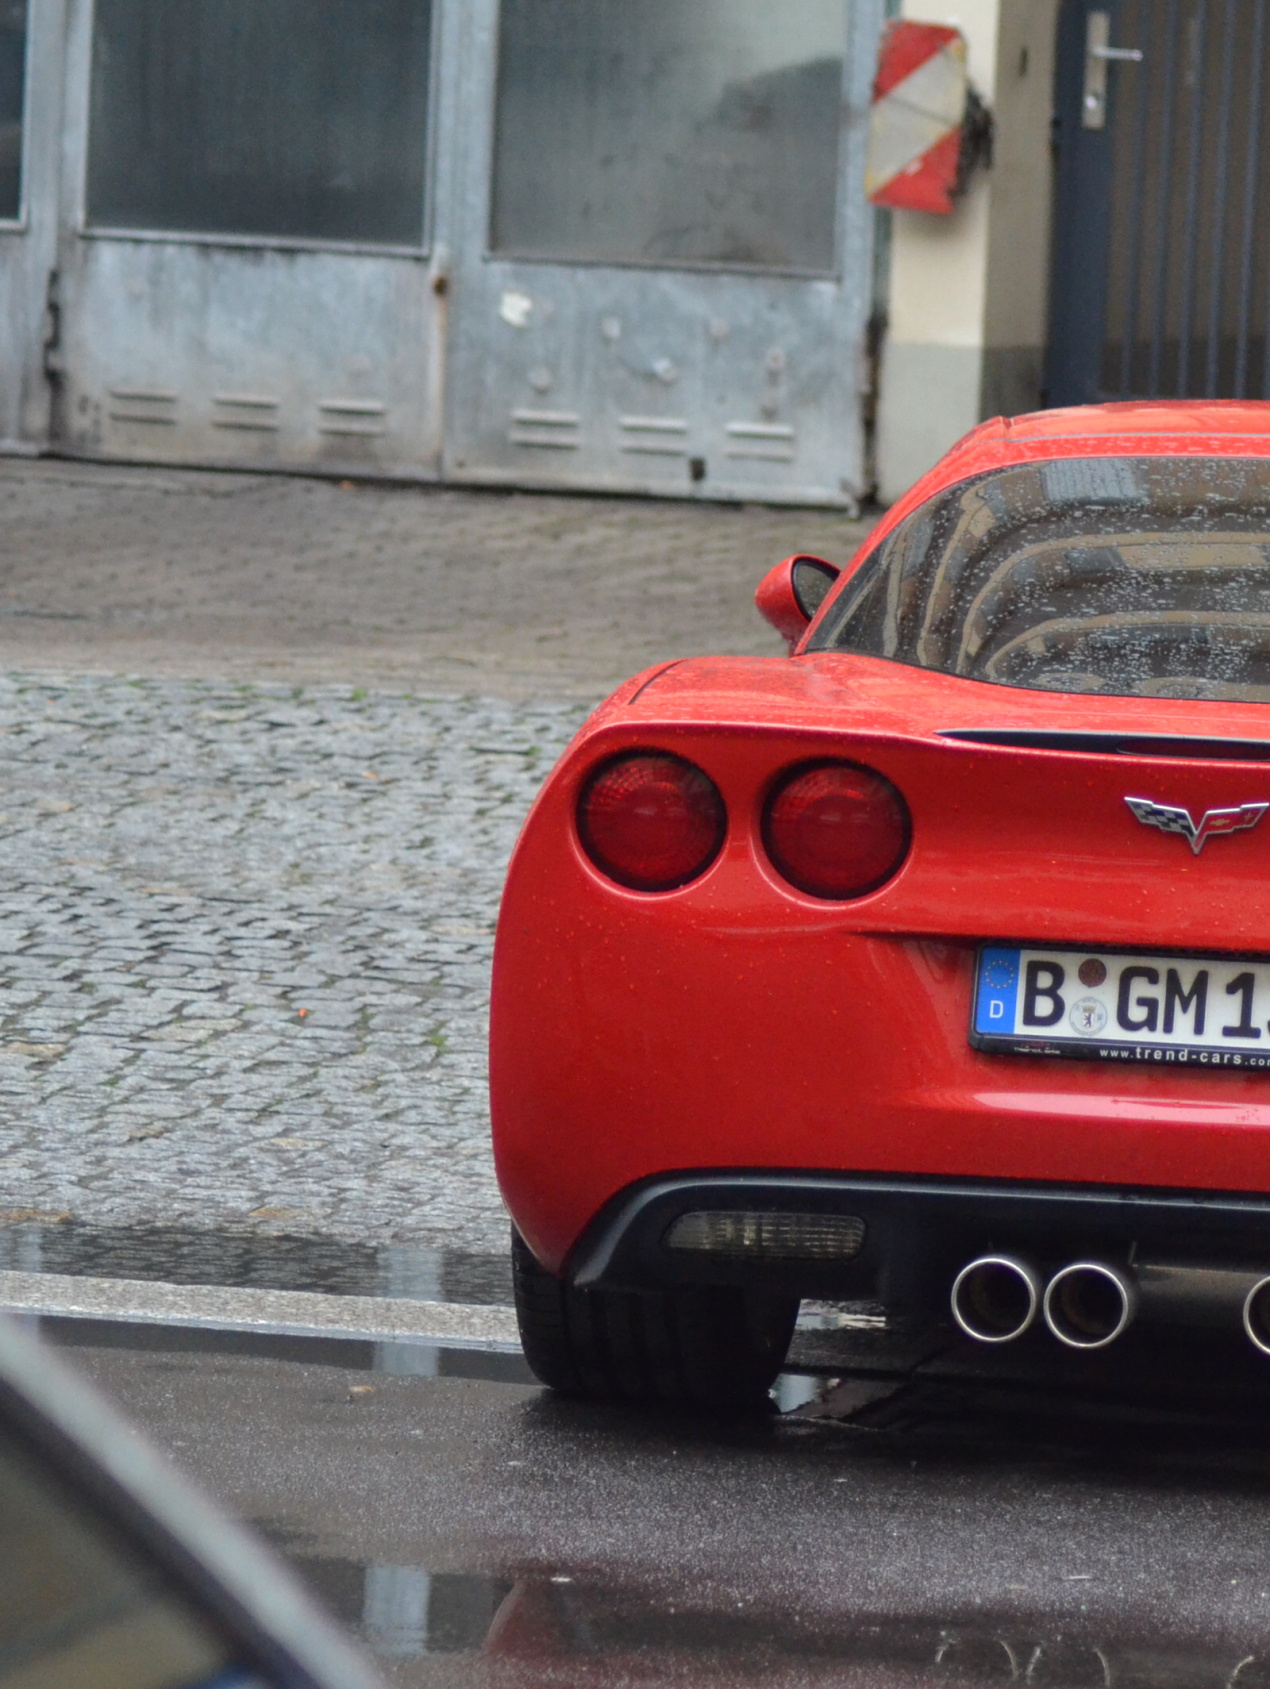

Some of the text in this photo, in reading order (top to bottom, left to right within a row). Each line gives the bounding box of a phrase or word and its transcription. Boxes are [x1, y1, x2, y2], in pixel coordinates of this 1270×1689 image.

[989, 1000, 1004, 1019] D
[1022, 959, 1066, 1028] B
[1116, 965, 1210, 1035] GM
